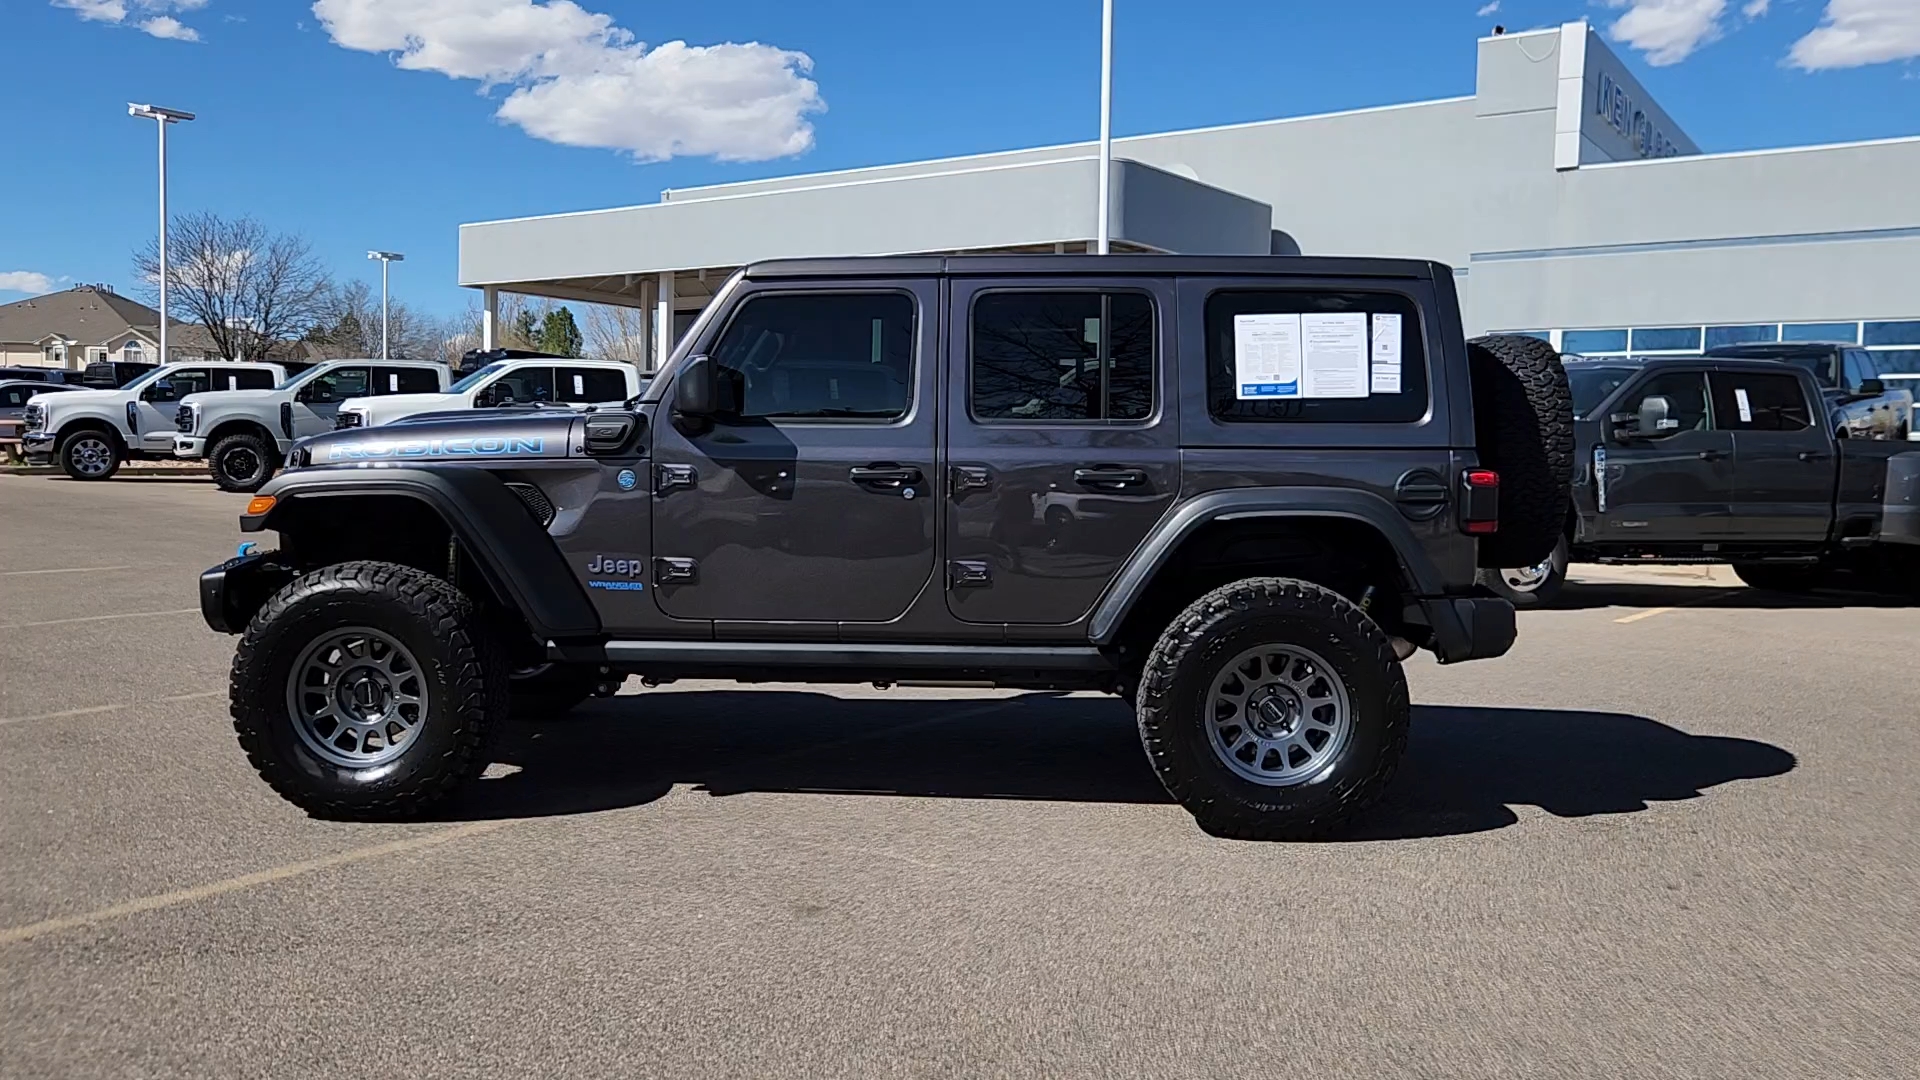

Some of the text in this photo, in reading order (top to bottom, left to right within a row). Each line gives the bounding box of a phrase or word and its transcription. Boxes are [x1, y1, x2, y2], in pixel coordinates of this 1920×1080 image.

[1598, 71, 1632, 136] KEN
[329, 436, 544, 459] RUBICON
[588, 554, 642, 578] Jeep
